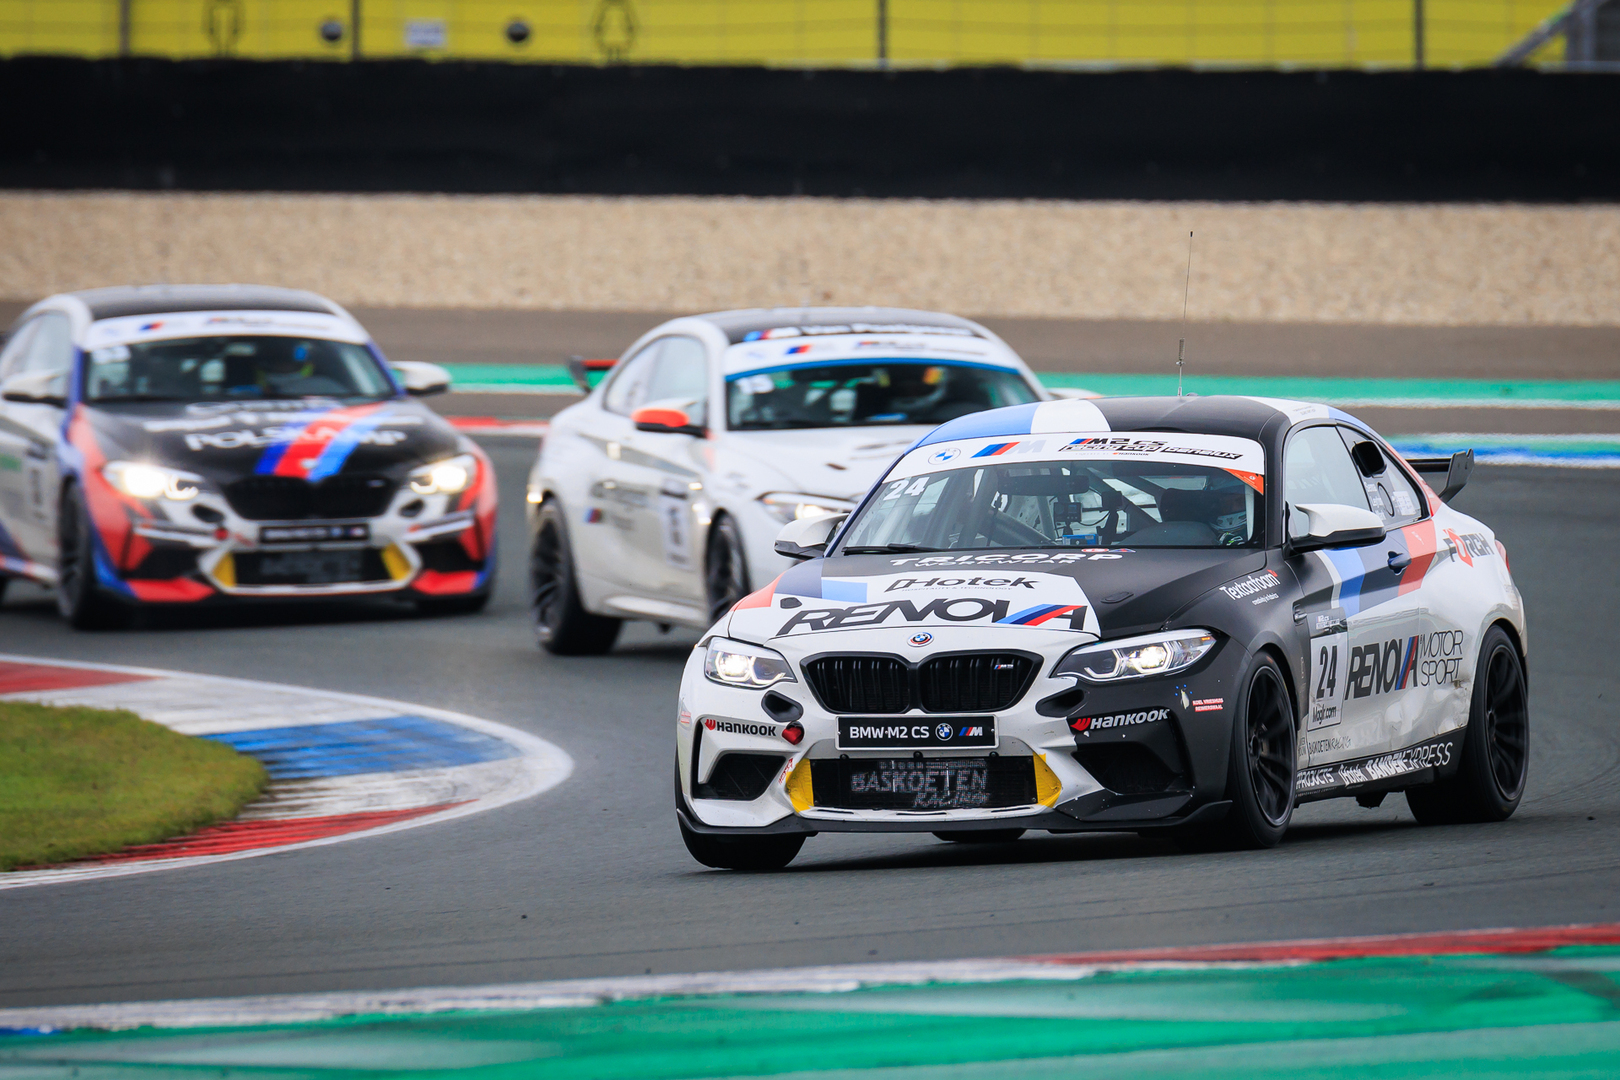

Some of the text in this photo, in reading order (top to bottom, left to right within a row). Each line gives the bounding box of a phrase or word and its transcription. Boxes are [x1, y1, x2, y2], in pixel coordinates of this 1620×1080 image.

[883, 477, 930, 501] 24
[890, 553, 1123, 566] TRICORP
[915, 559, 1076, 567] WORKWEAR
[1420, 630, 1464, 658] MOTOR
[1316, 645, 1338, 699] 24
[1421, 657, 1463, 687] SPORT
[849, 726, 884, 739] BMW
[887, 726, 908, 739] M2
[911, 726, 930, 739] CS
[851, 769, 987, 792] BASKOETEN
